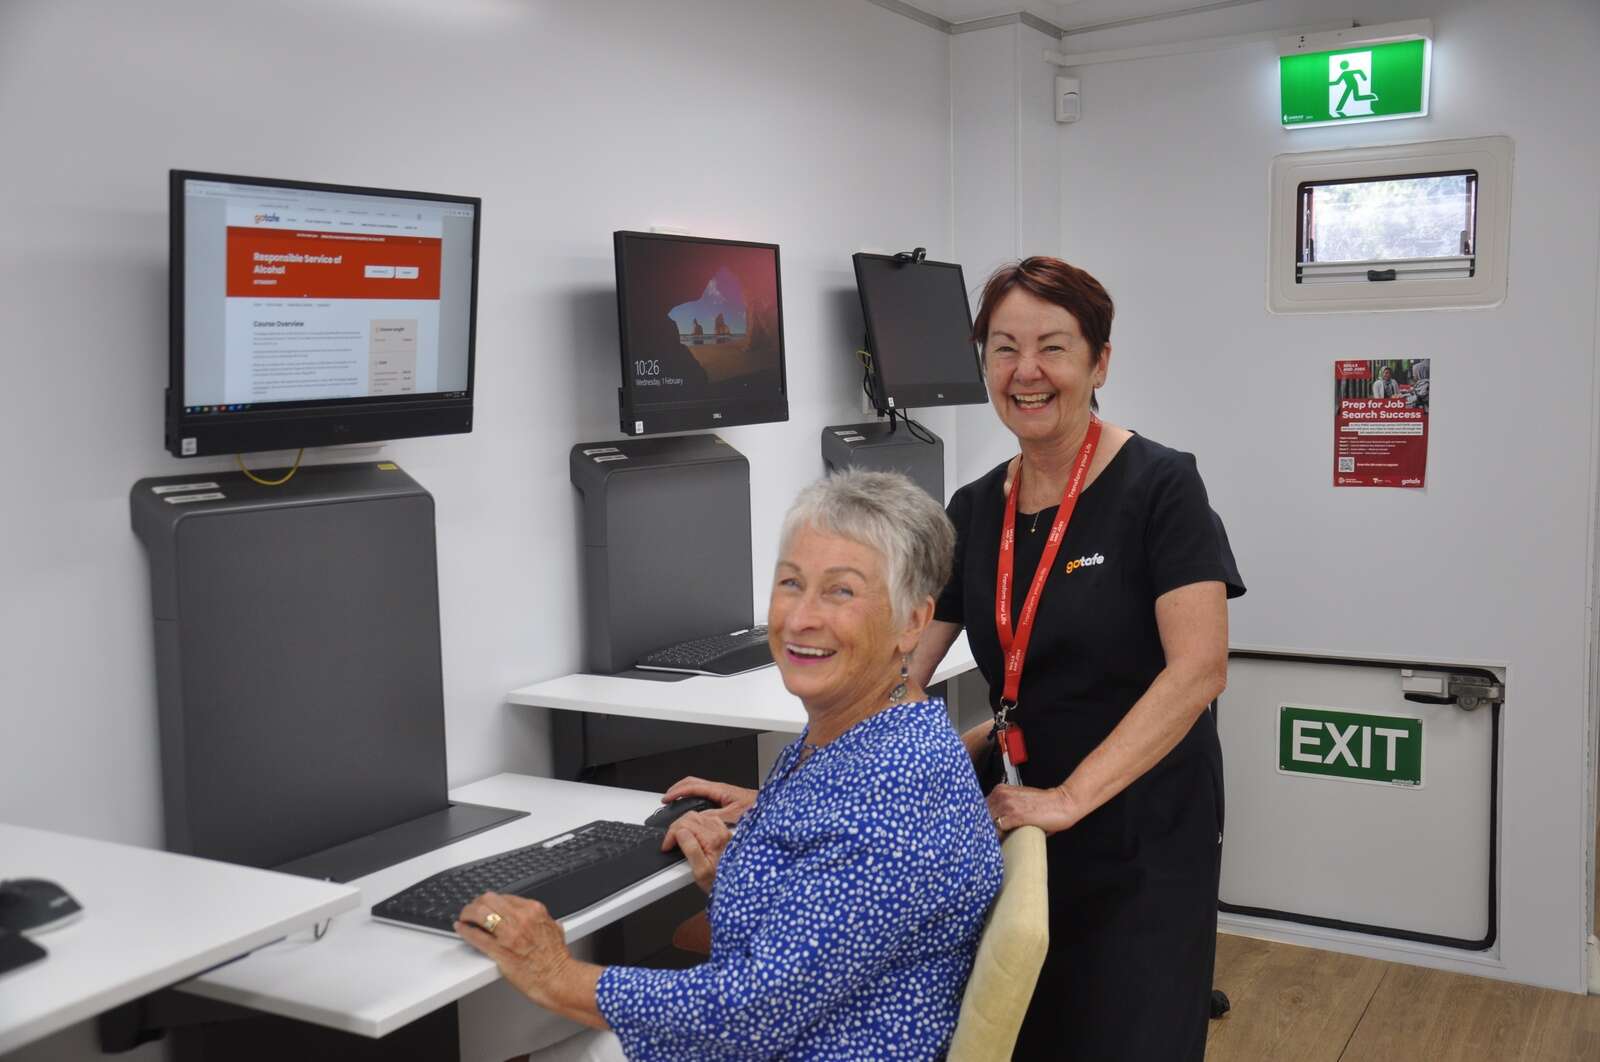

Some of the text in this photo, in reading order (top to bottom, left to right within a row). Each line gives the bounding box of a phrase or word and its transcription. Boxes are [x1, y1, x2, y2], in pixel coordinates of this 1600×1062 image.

[255, 213, 280, 224] gotafe
[253, 252, 342, 265] Responsible Service of
[253, 265, 286, 274] Alcohol
[634, 359, 660, 376] 10:26
[1342, 400, 1405, 410] Prep for Job
[1342, 410, 1422, 419] Search Success
[1065, 552, 1105, 574] gotafe
[1292, 719, 1409, 771] EXIT
